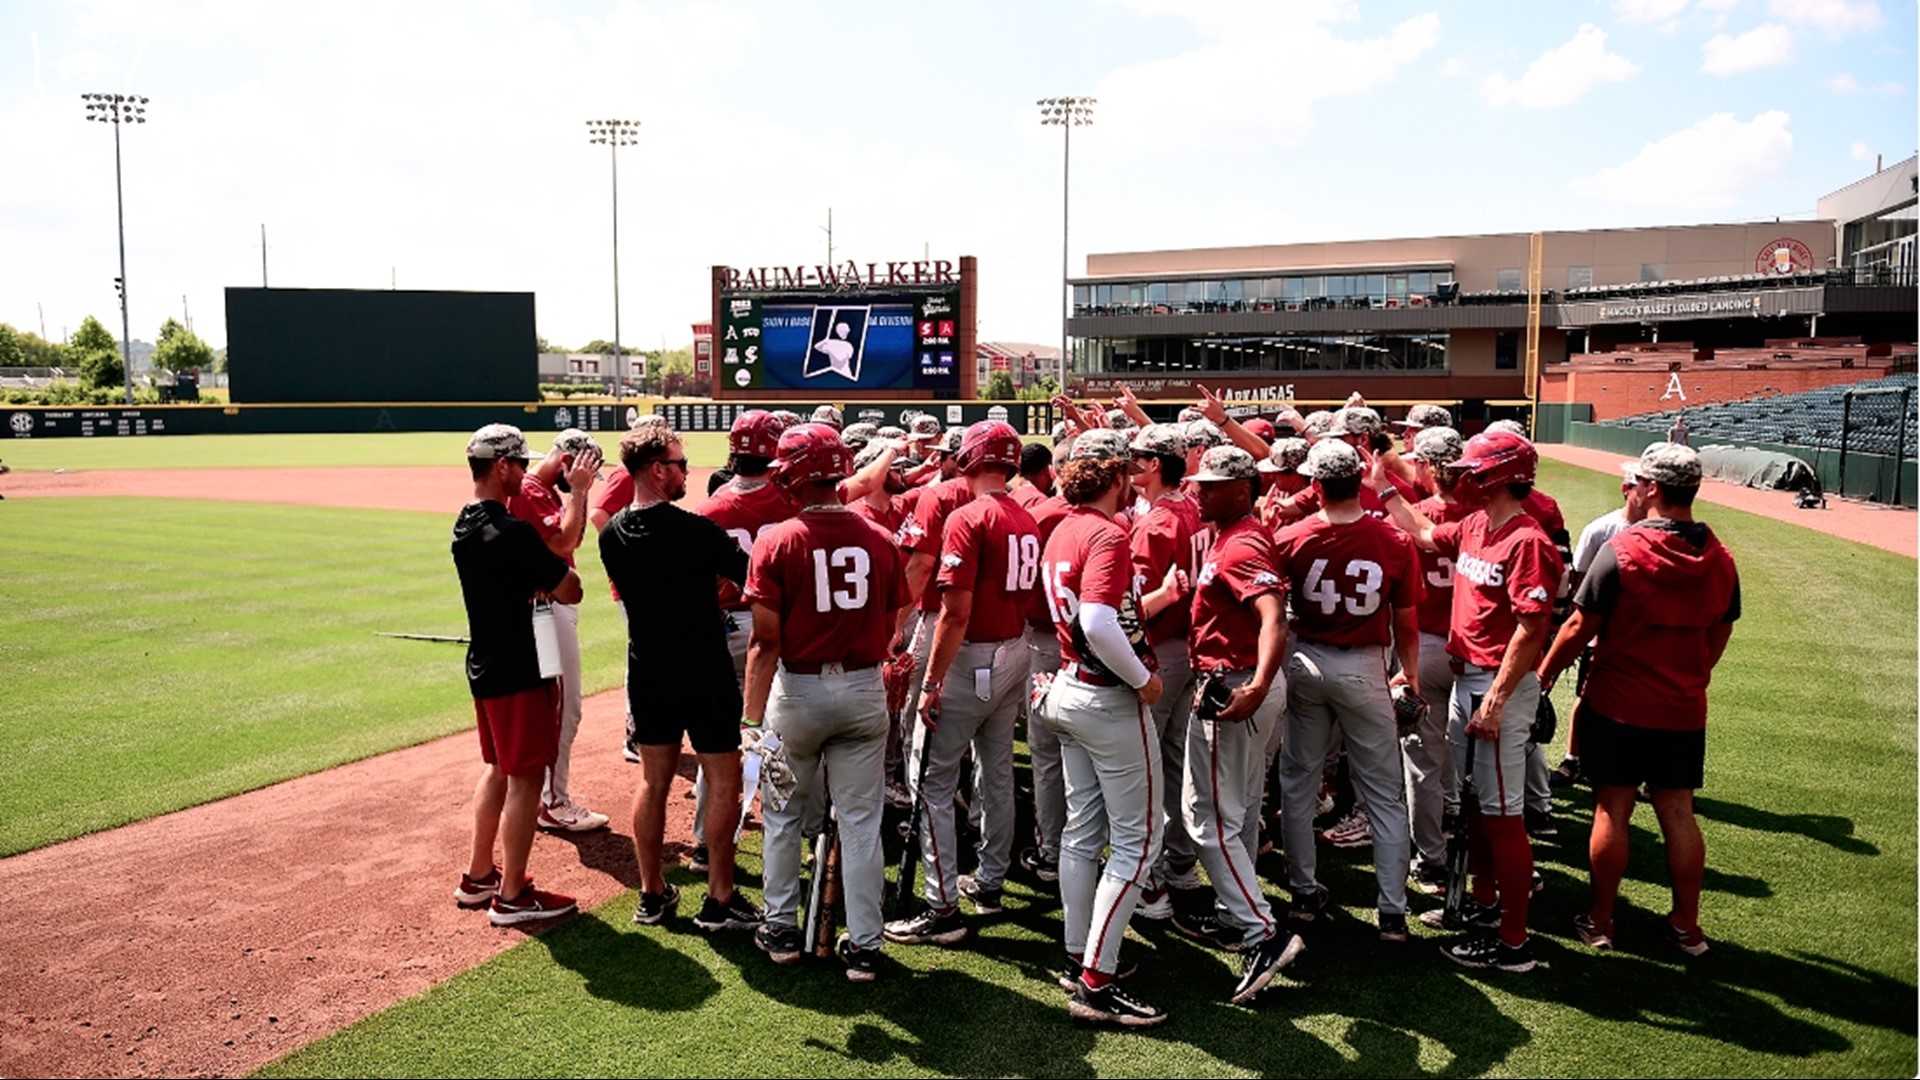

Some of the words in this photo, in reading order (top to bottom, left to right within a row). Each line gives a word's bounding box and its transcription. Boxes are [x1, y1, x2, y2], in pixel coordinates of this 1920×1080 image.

[723, 259, 957, 291] BAUM-WALKER
[1673, 301, 1708, 313] LOADED
[1710, 298, 1752, 311] LANDING
[1225, 384, 1295, 405] ARKANSAS
[1660, 372, 1687, 400] A
[813, 546, 870, 613] 13
[1006, 534, 1040, 591] 18
[1041, 561, 1079, 623] 15
[1302, 558, 1383, 616] 43
